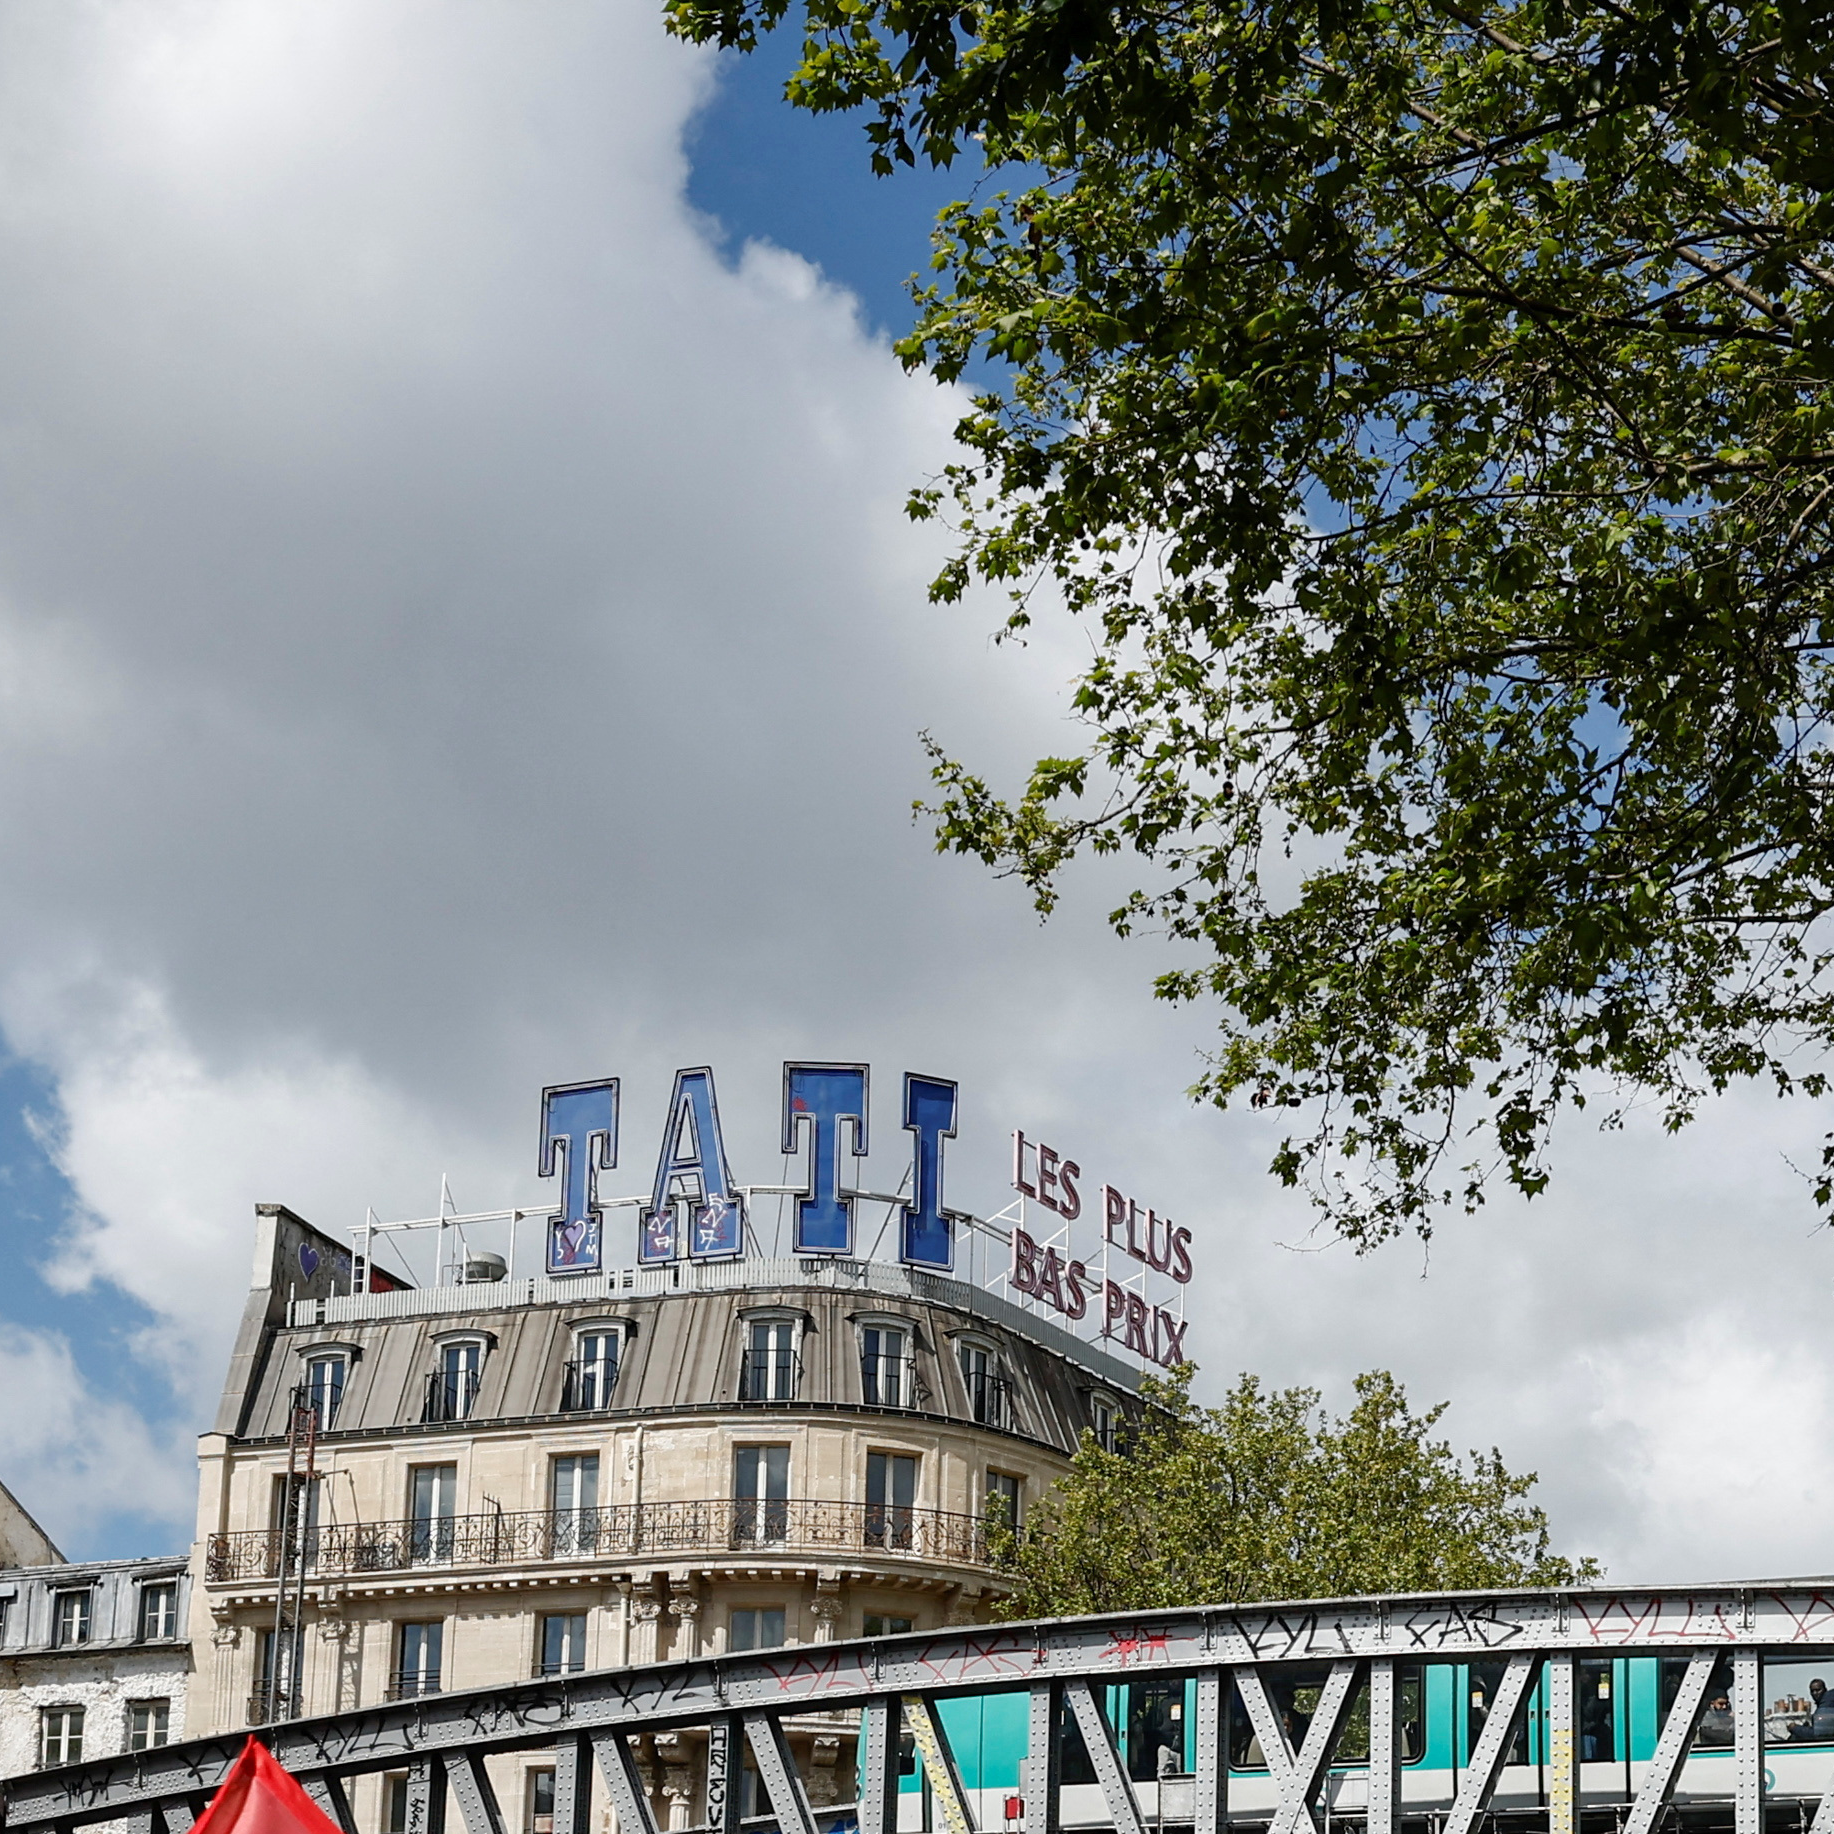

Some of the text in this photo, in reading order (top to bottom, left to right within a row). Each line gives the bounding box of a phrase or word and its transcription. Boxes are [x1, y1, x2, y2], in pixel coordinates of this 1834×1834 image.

[538, 1061, 959, 1274] TATI
[1011, 1129, 1193, 1284] LES PLUS
[1011, 1227, 1188, 1368] BAS PRIX
